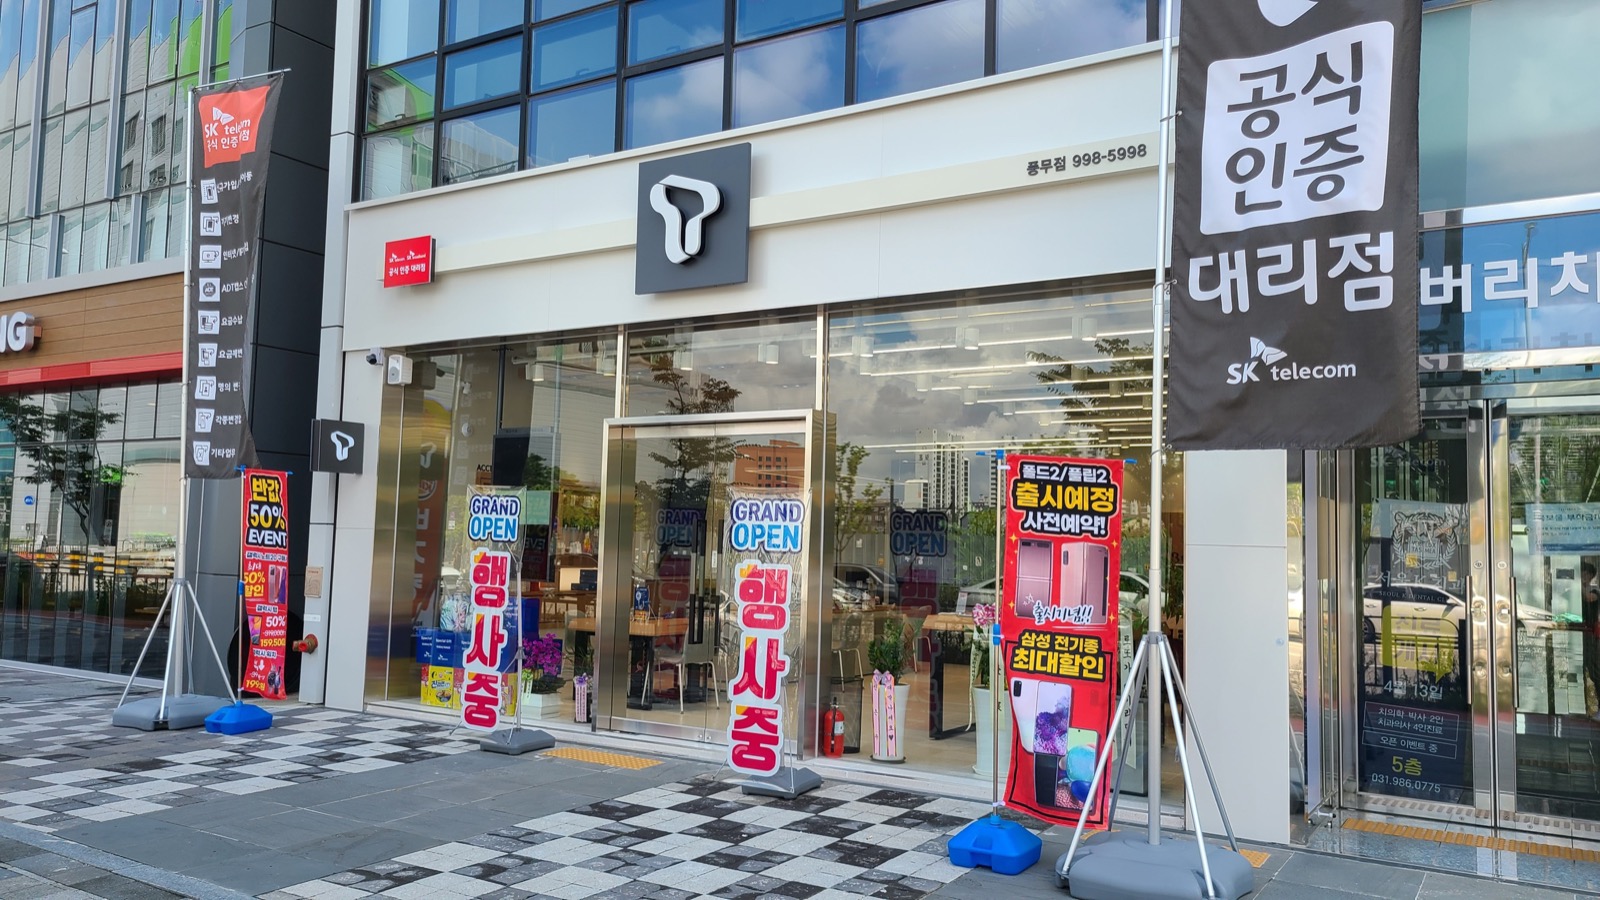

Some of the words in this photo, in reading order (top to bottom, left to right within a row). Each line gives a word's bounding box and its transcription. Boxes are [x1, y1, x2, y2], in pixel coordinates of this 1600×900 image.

[1227, 40, 1363, 139] 공식
[204, 122, 219, 138] SK
[220, 136, 238, 149] 인증
[1026, 156, 1066, 176] 풍무점
[1072, 144, 1147, 168] 998-5998
[1225, 124, 1365, 215] 인증
[389, 267, 399, 277] 공식
[400, 265, 410, 275] 인증
[411, 263, 426, 272] 대리점
[1188, 231, 1394, 314] 대리점
[221, 314, 243, 327] 요금수납
[1226, 361, 1260, 385] SK
[1270, 362, 1357, 381] telecom
[1022, 464, 1108, 484] 폴드2/플립2
[252, 477, 280, 503] 반값
[1015, 482, 1114, 513] 출시예정
[250, 503, 286, 529] 50%
[472, 498, 519, 516] GRAND
[733, 502, 802, 523] GRAND
[470, 517, 517, 540] OPEN
[1023, 511, 1106, 535] 사전예약!
[248, 528, 288, 547] EVENT
[733, 524, 801, 549] OPEN
[244, 571, 266, 584] 50%
[244, 584, 264, 598] 할인
[265, 616, 286, 627] 50%
[1034, 602, 1093, 624] 출시기념!!
[464, 552, 509, 728] 행사중
[1021, 632, 1051, 649] 삼성
[1054, 635, 1099, 654] 전기종
[731, 564, 788, 772] 행사중
[1013, 648, 1104, 680] 최대할인
[1413, 683, 1443, 700] 13일
[1378, 707, 1405, 719] 치의학
[1408, 712, 1427, 722] 박사
[1429, 715, 1444, 725] 2인
[1378, 718, 1411, 730] 치과의사
[1413, 723, 1444, 735] 4인진료
[1380, 736, 1397, 746] 오픈
[1400, 740, 1426, 751] 이벤트
[1429, 744, 1438, 753] 중
[1391, 755, 1423, 776] 5층
[1371, 773, 1441, 793] 031.986.0775
